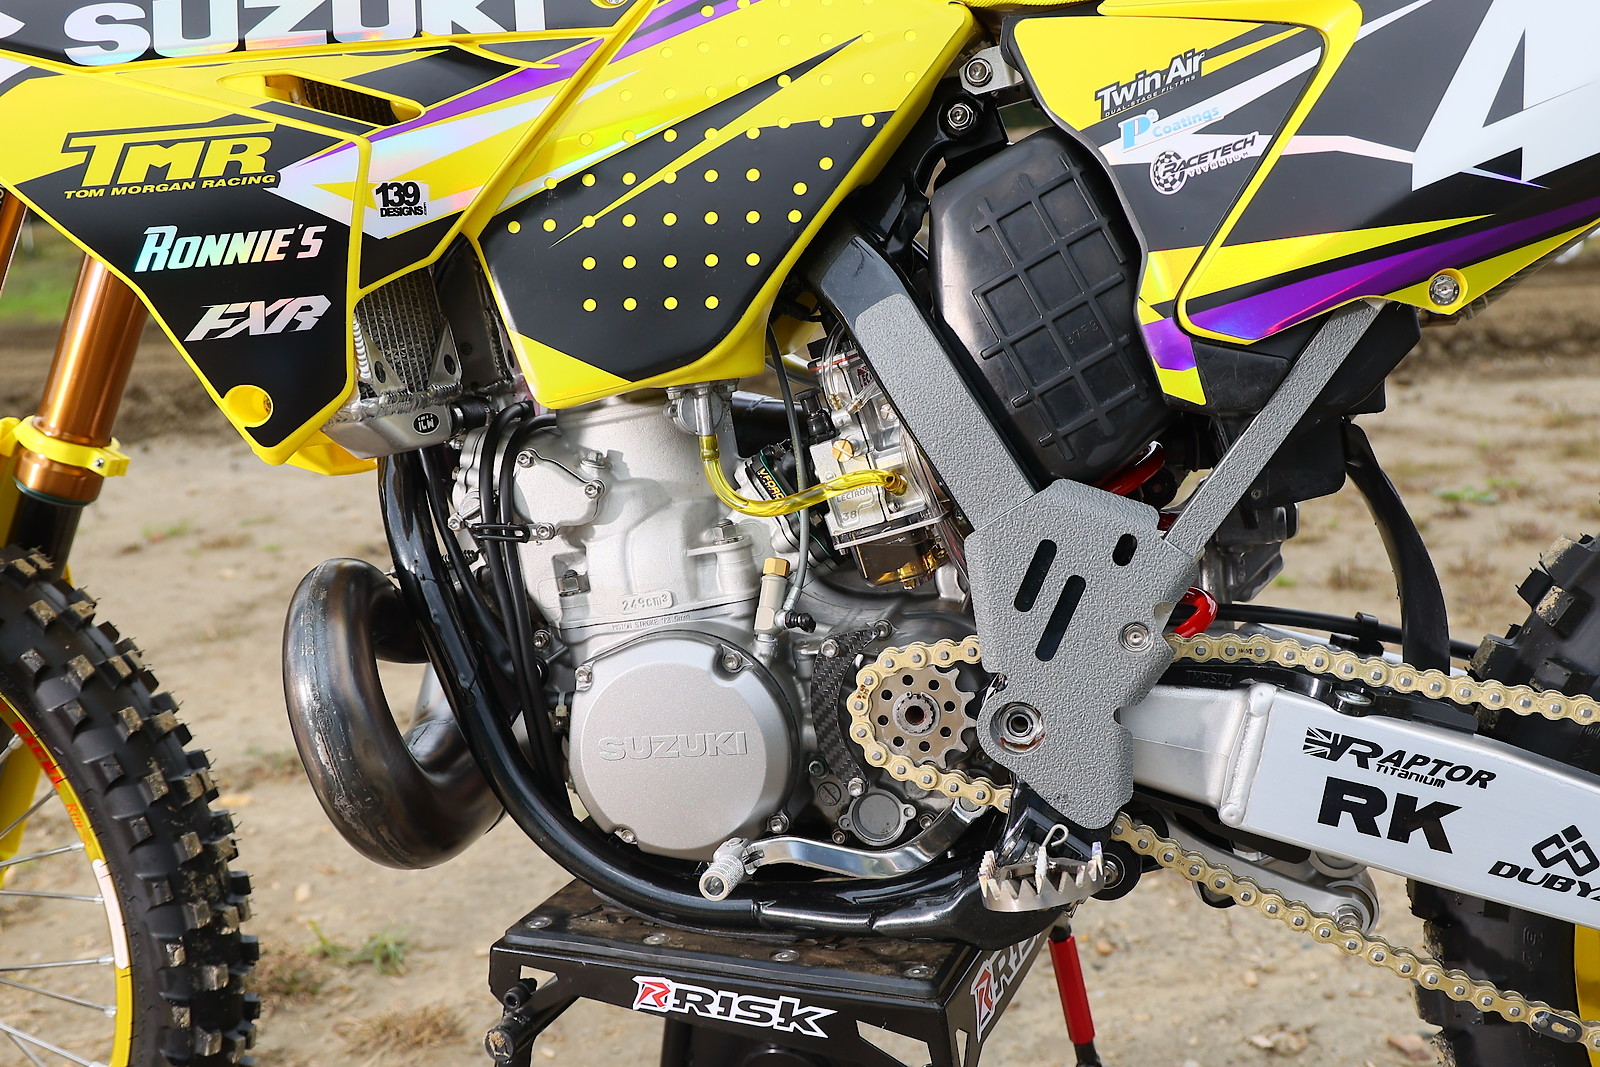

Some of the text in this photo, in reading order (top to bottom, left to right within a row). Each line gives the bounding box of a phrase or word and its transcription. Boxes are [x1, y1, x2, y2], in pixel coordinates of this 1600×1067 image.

[63, 0, 545, 66] SUZUKI
[1097, 51, 1203, 112] Twin Air
[1105, 75, 1196, 118] DUAL-STAGE FILTERS
[1152, 106, 1220, 138] Coatings
[69, 122, 277, 187] TMR
[1162, 134, 1256, 177] RACETECH
[1188, 151, 1250, 178] TITANIUM
[64, 174, 277, 200] TOM MORGAN RACING
[375, 181, 421, 208] 139
[380, 206, 424, 218] DESIGNS
[134, 223, 328, 273] RONNIE'S
[184, 294, 332, 342] FXR
[842, 510, 857, 521] 38
[598, 730, 749, 762] SUZUKI
[1322, 732, 1498, 791] RAPTOR
[1317, 775, 1463, 855] RK
